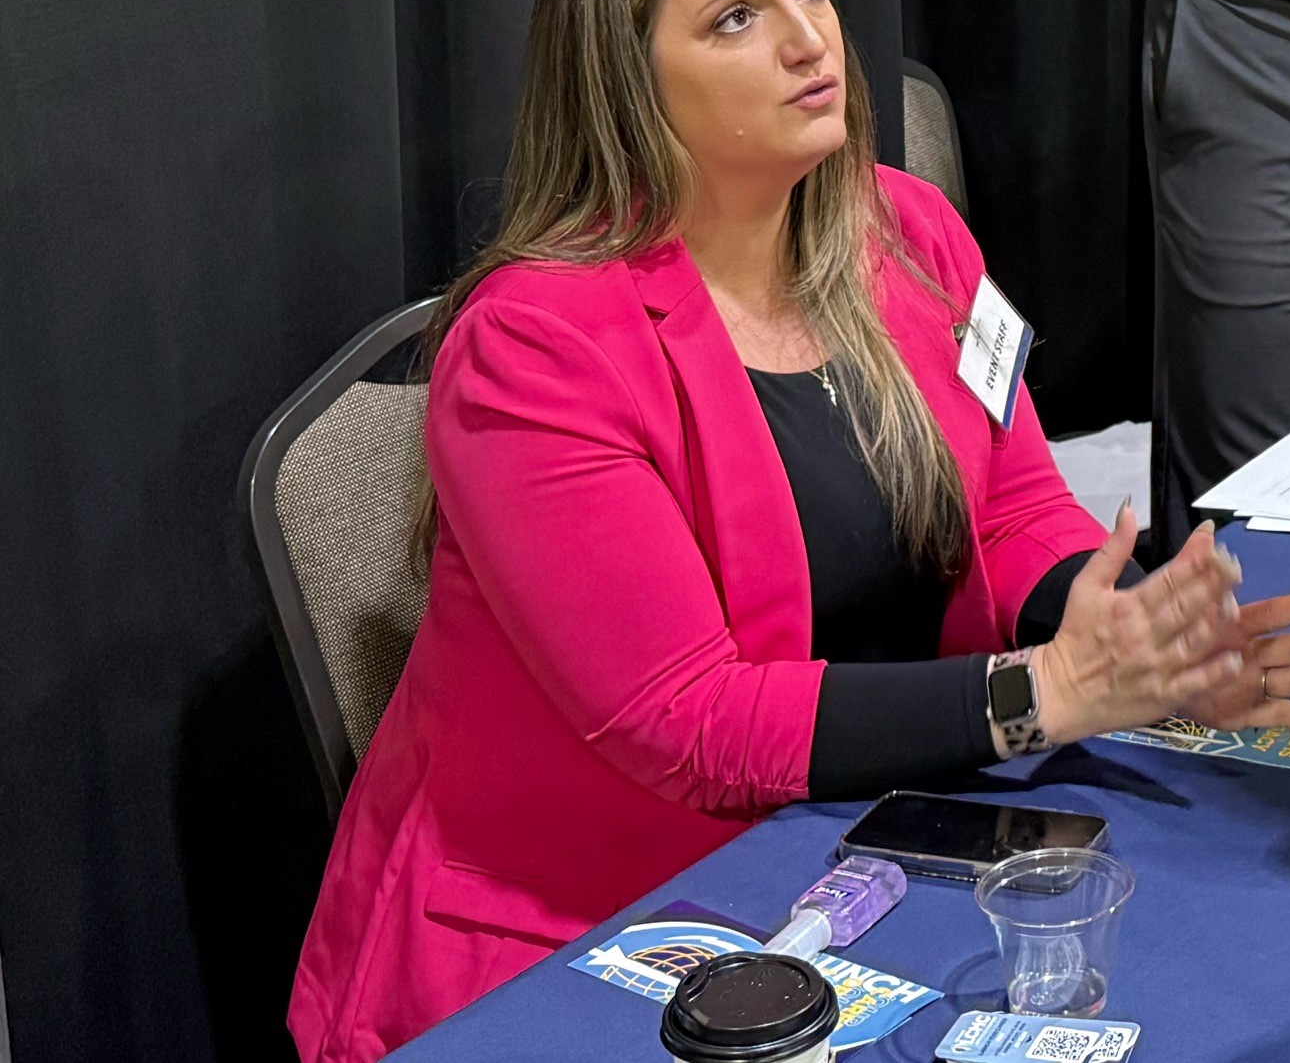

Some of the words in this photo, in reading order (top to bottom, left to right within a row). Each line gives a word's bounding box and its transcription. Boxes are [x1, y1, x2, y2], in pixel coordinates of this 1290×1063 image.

[985, 351, 1000, 391] EVENT
[994, 319, 1008, 354] STAFF
[814, 955, 930, 1004] UNCH
